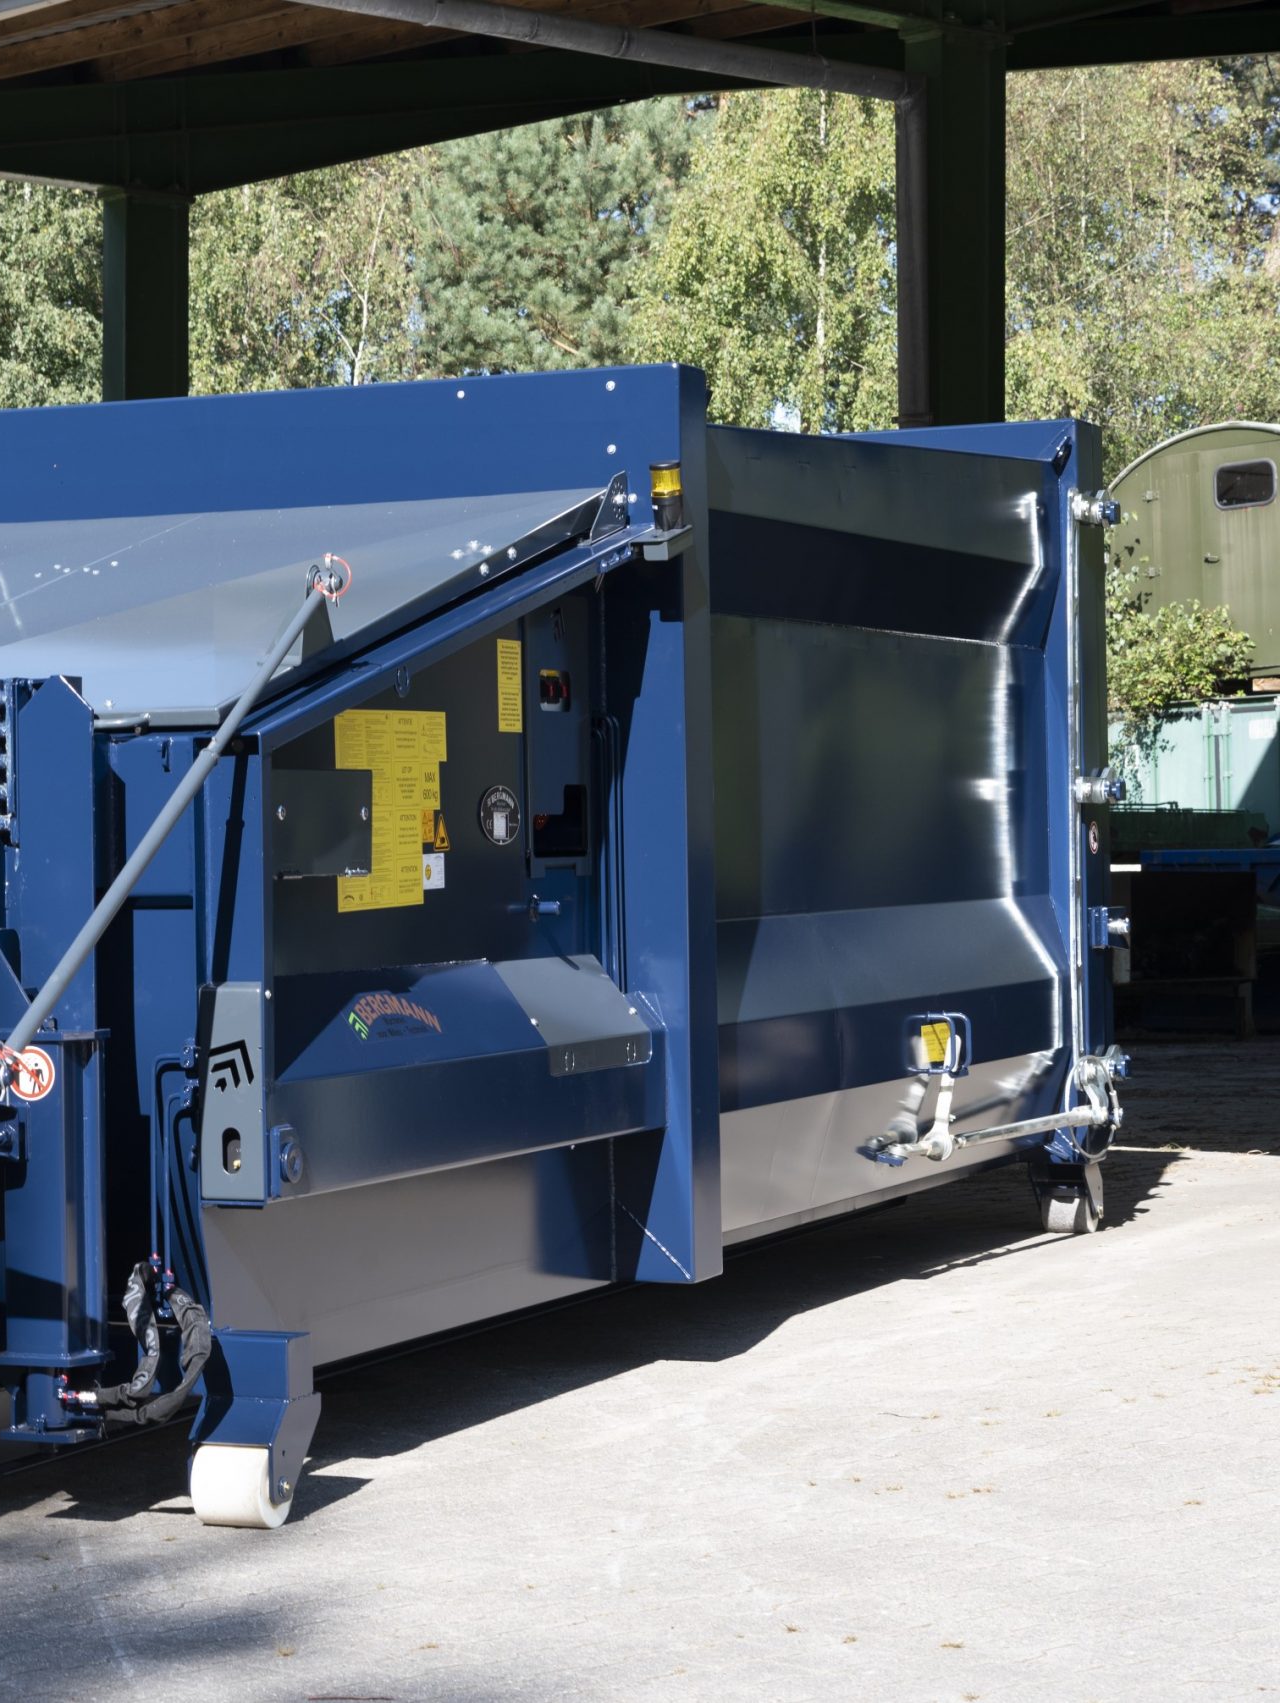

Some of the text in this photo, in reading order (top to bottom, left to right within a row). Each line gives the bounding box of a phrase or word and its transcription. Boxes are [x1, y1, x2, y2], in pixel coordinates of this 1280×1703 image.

[424, 771, 436, 783] MAX
[422, 788, 432, 800] 600
[354, 994, 442, 1033] BERGMANN
